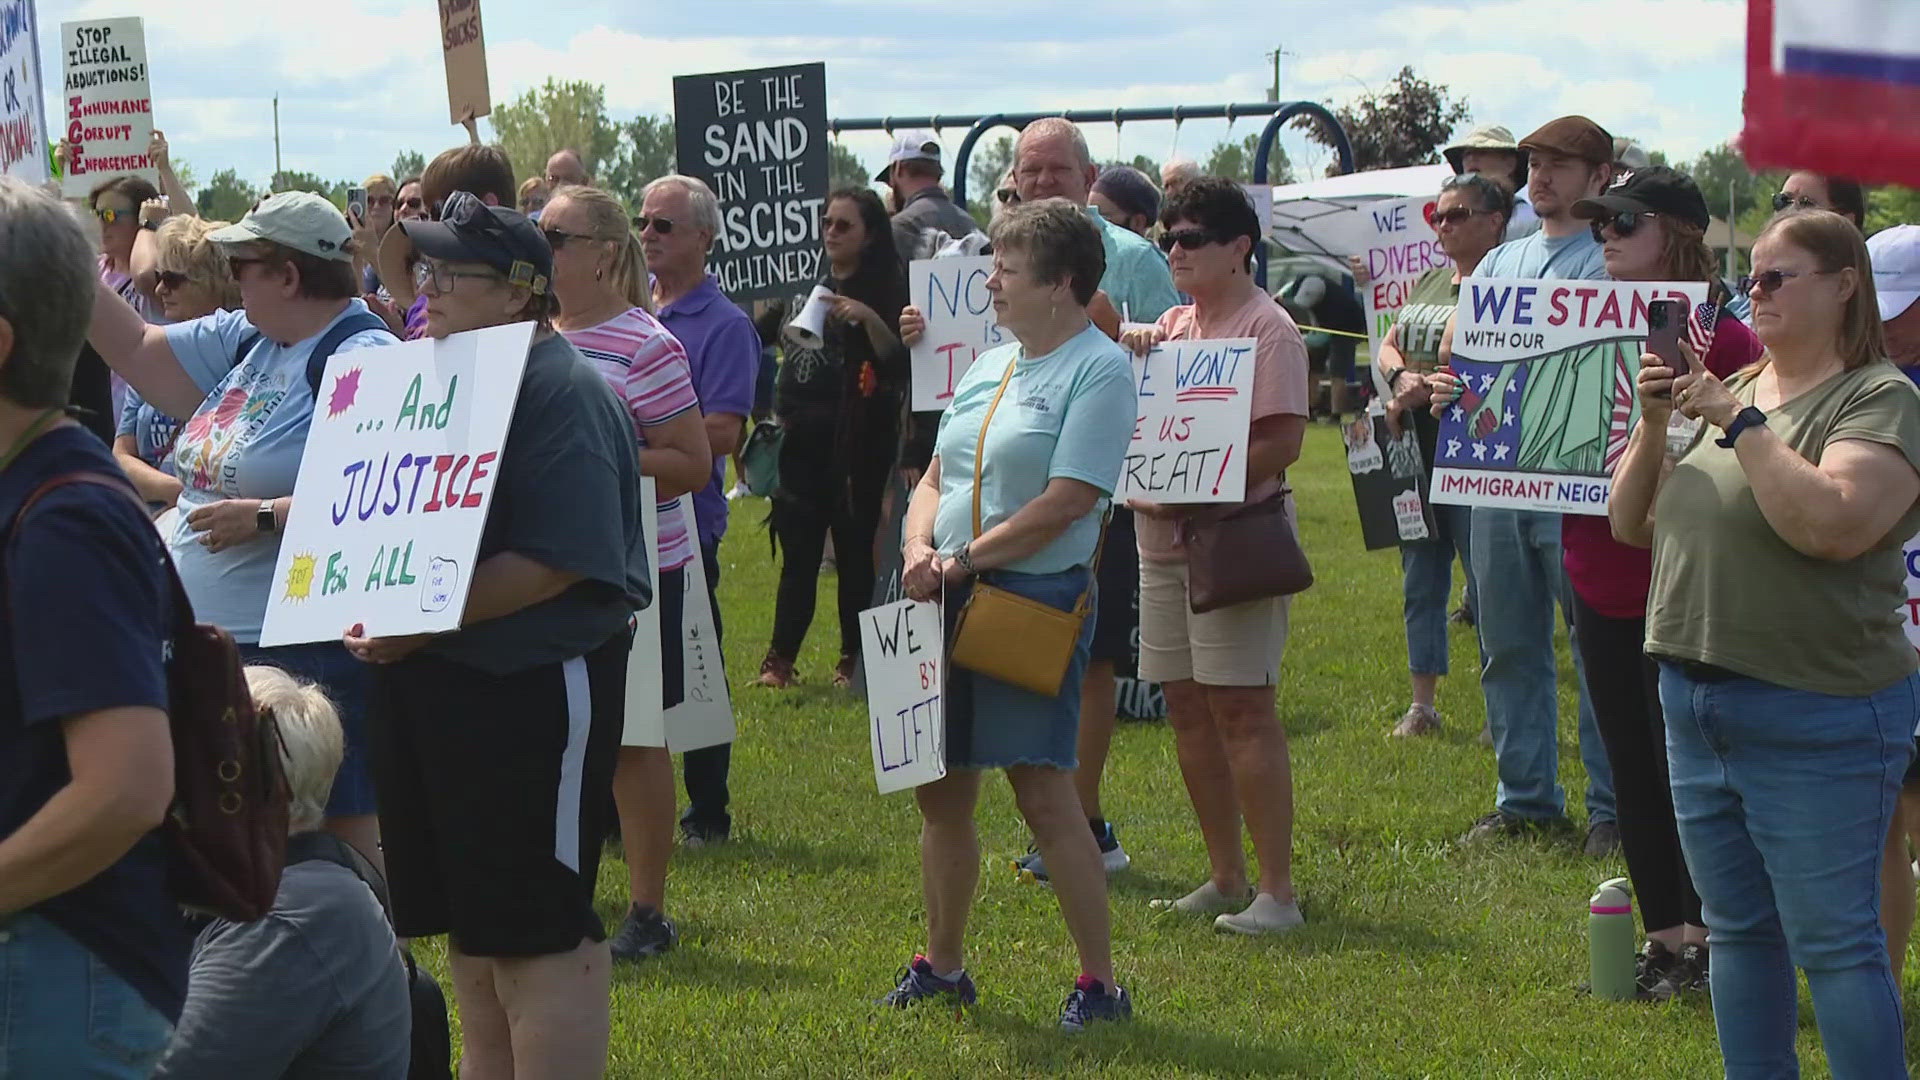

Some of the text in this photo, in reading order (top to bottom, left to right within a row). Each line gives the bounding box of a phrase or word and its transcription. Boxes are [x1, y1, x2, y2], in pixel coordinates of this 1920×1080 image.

[69, 45, 131, 67] ILLEGAL
[76, 26, 111, 48] STOP
[4, 66, 20, 115] OR
[65, 63, 145, 91] ABDUCTIONS!
[714, 74, 805, 118] BE THE
[69, 95, 150, 120] INHUMANE
[68, 119, 132, 145] CORRUPT
[703, 116, 809, 167] SAND
[713, 162, 806, 204] IN THE
[706, 198, 825, 254] ASCIST
[1373, 204, 1407, 234] WE
[1368, 239, 1452, 281] DIVERS
[1471, 284, 1537, 326] WE
[984, 319, 1002, 344] is
[1464, 330, 1544, 350] WITH OUR
[1176, 346, 1252, 390] WON'T
[394, 372, 458, 432] And
[1158, 414, 1196, 442] US
[331, 450, 498, 527] JUSTICE
[1124, 443, 1234, 497] REAT!
[1441, 473, 1554, 500] IMMIGRANT
[365, 539, 416, 592] ALL
[872, 603, 922, 658] WE
[919, 658, 936, 690] BY
